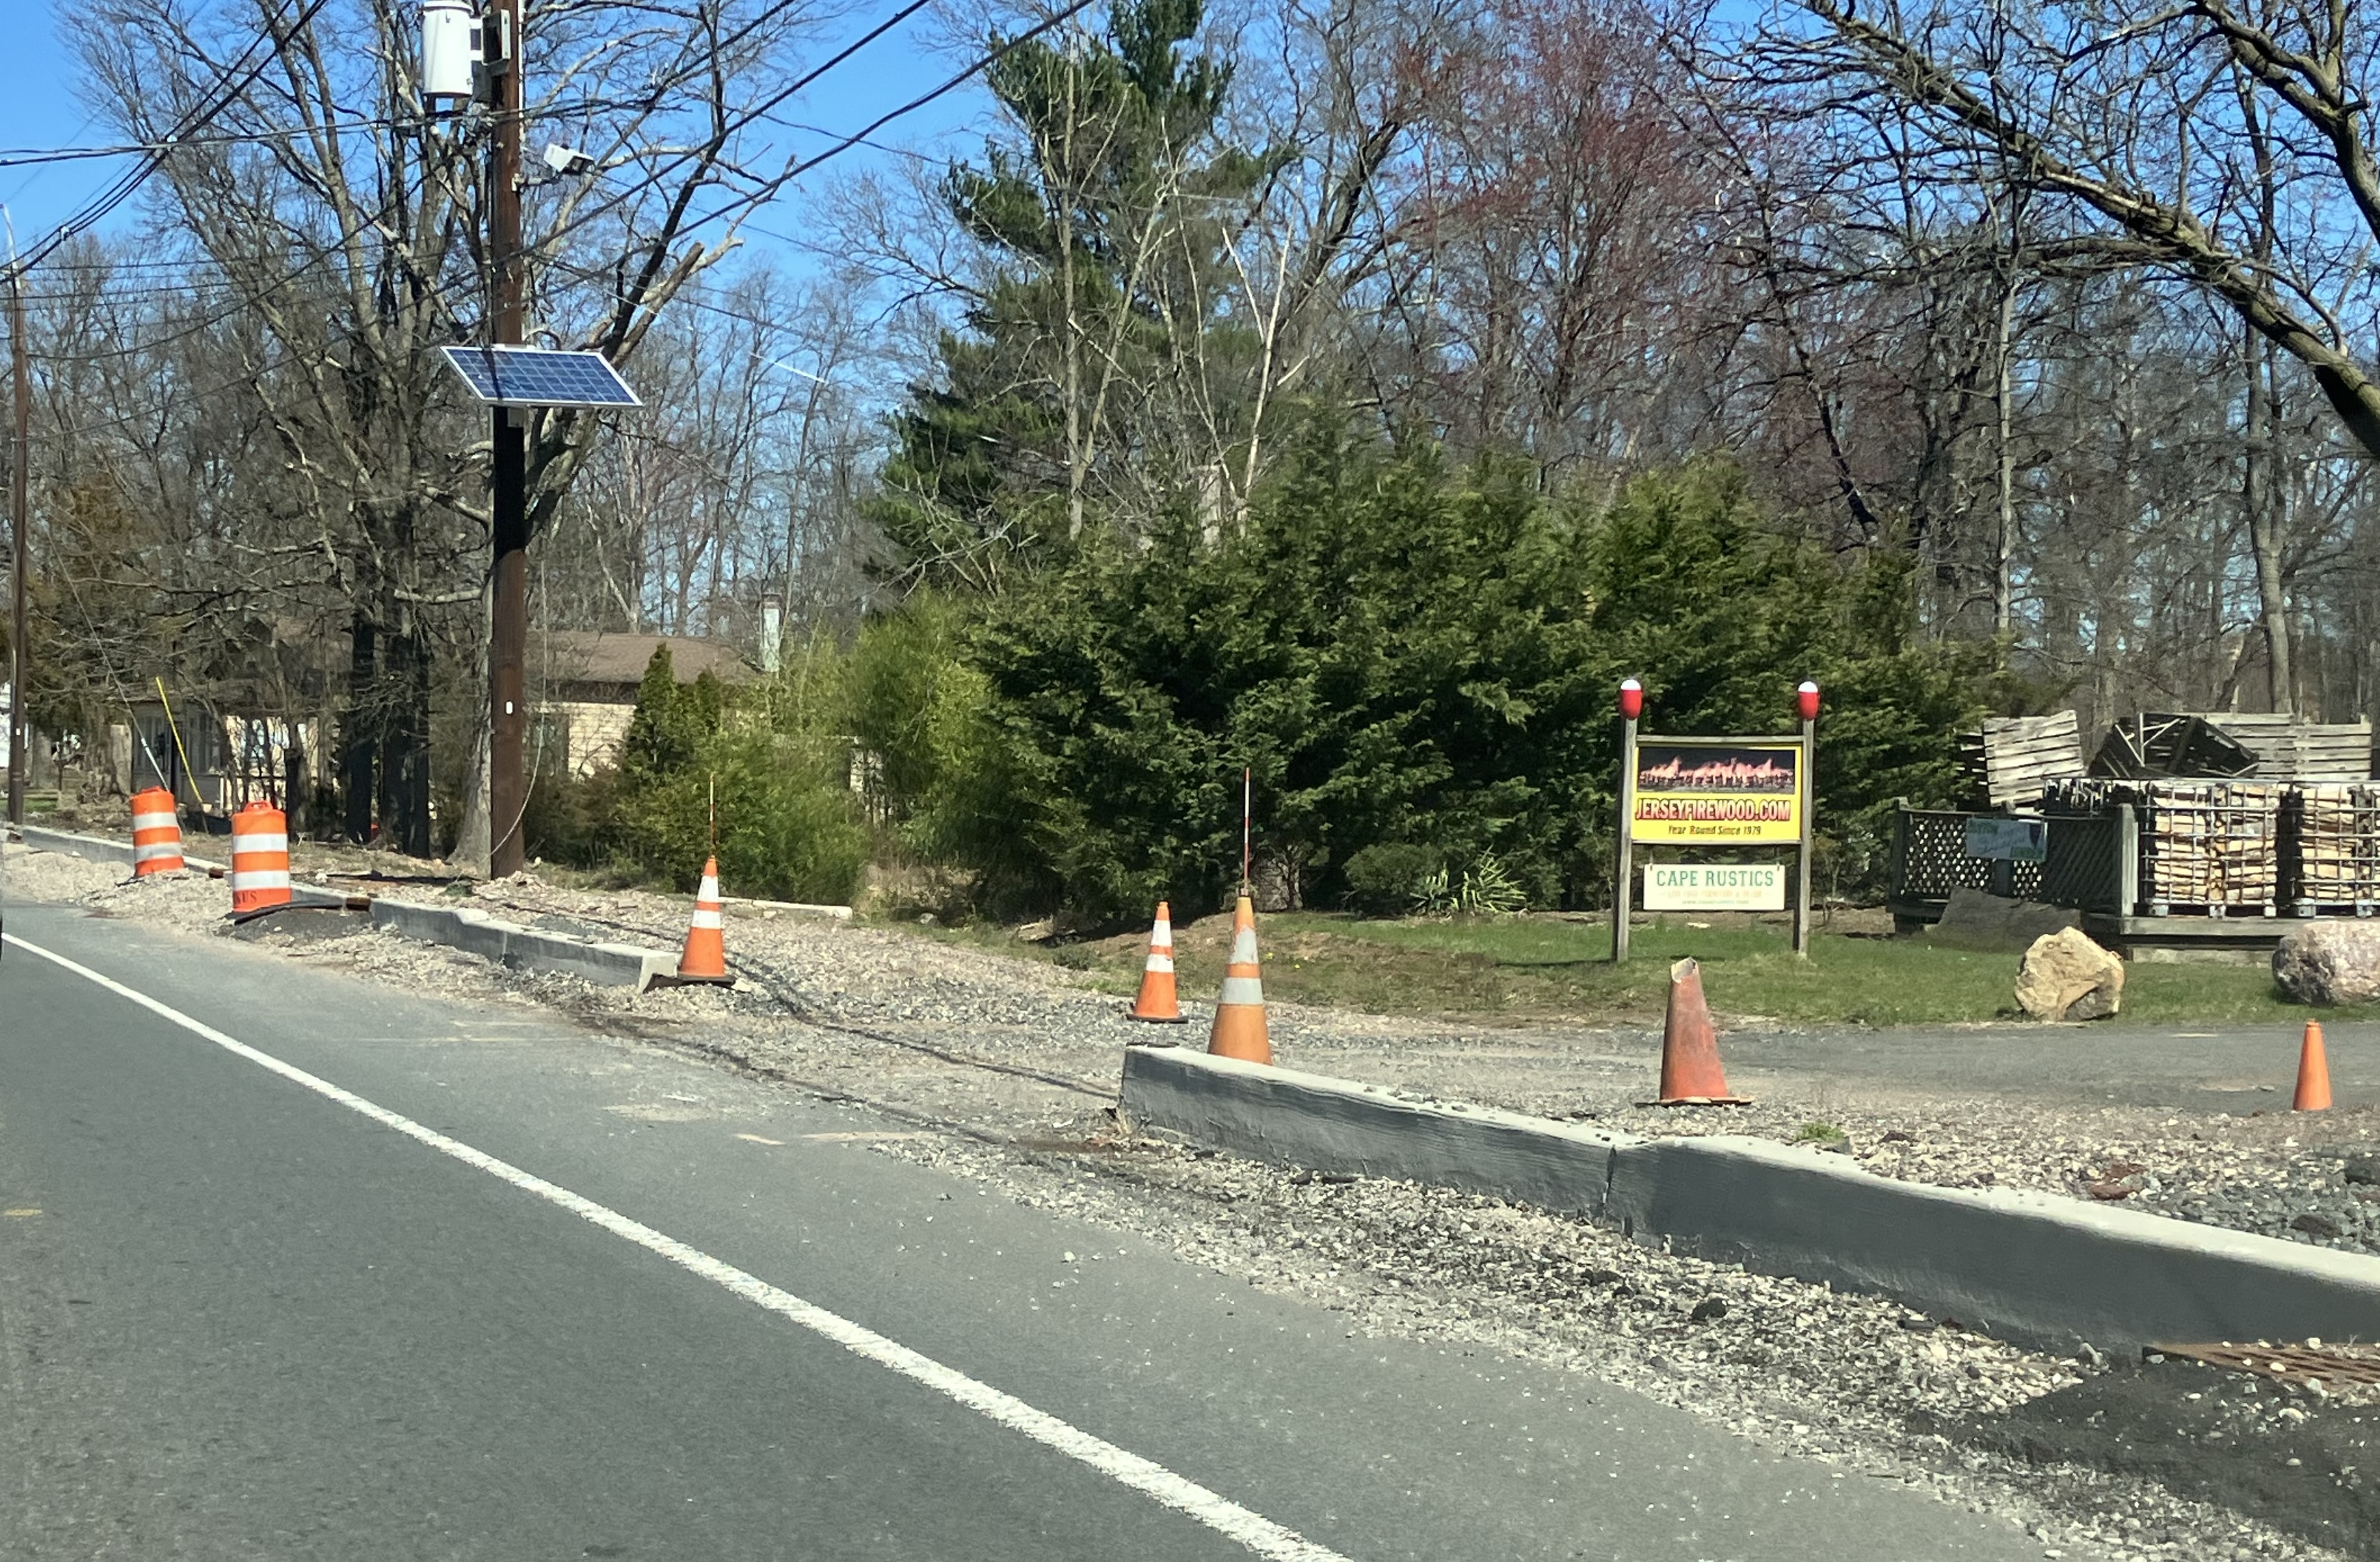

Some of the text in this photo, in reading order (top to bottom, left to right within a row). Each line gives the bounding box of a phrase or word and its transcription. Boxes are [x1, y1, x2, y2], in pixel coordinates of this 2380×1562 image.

[1635, 798, 1791, 821] JERSEYFIREWOOD.COM
[1689, 825, 1716, 835] Round
[1717, 825, 1741, 835] Since
[1656, 870, 1774, 887] CAPE RUSTICS
